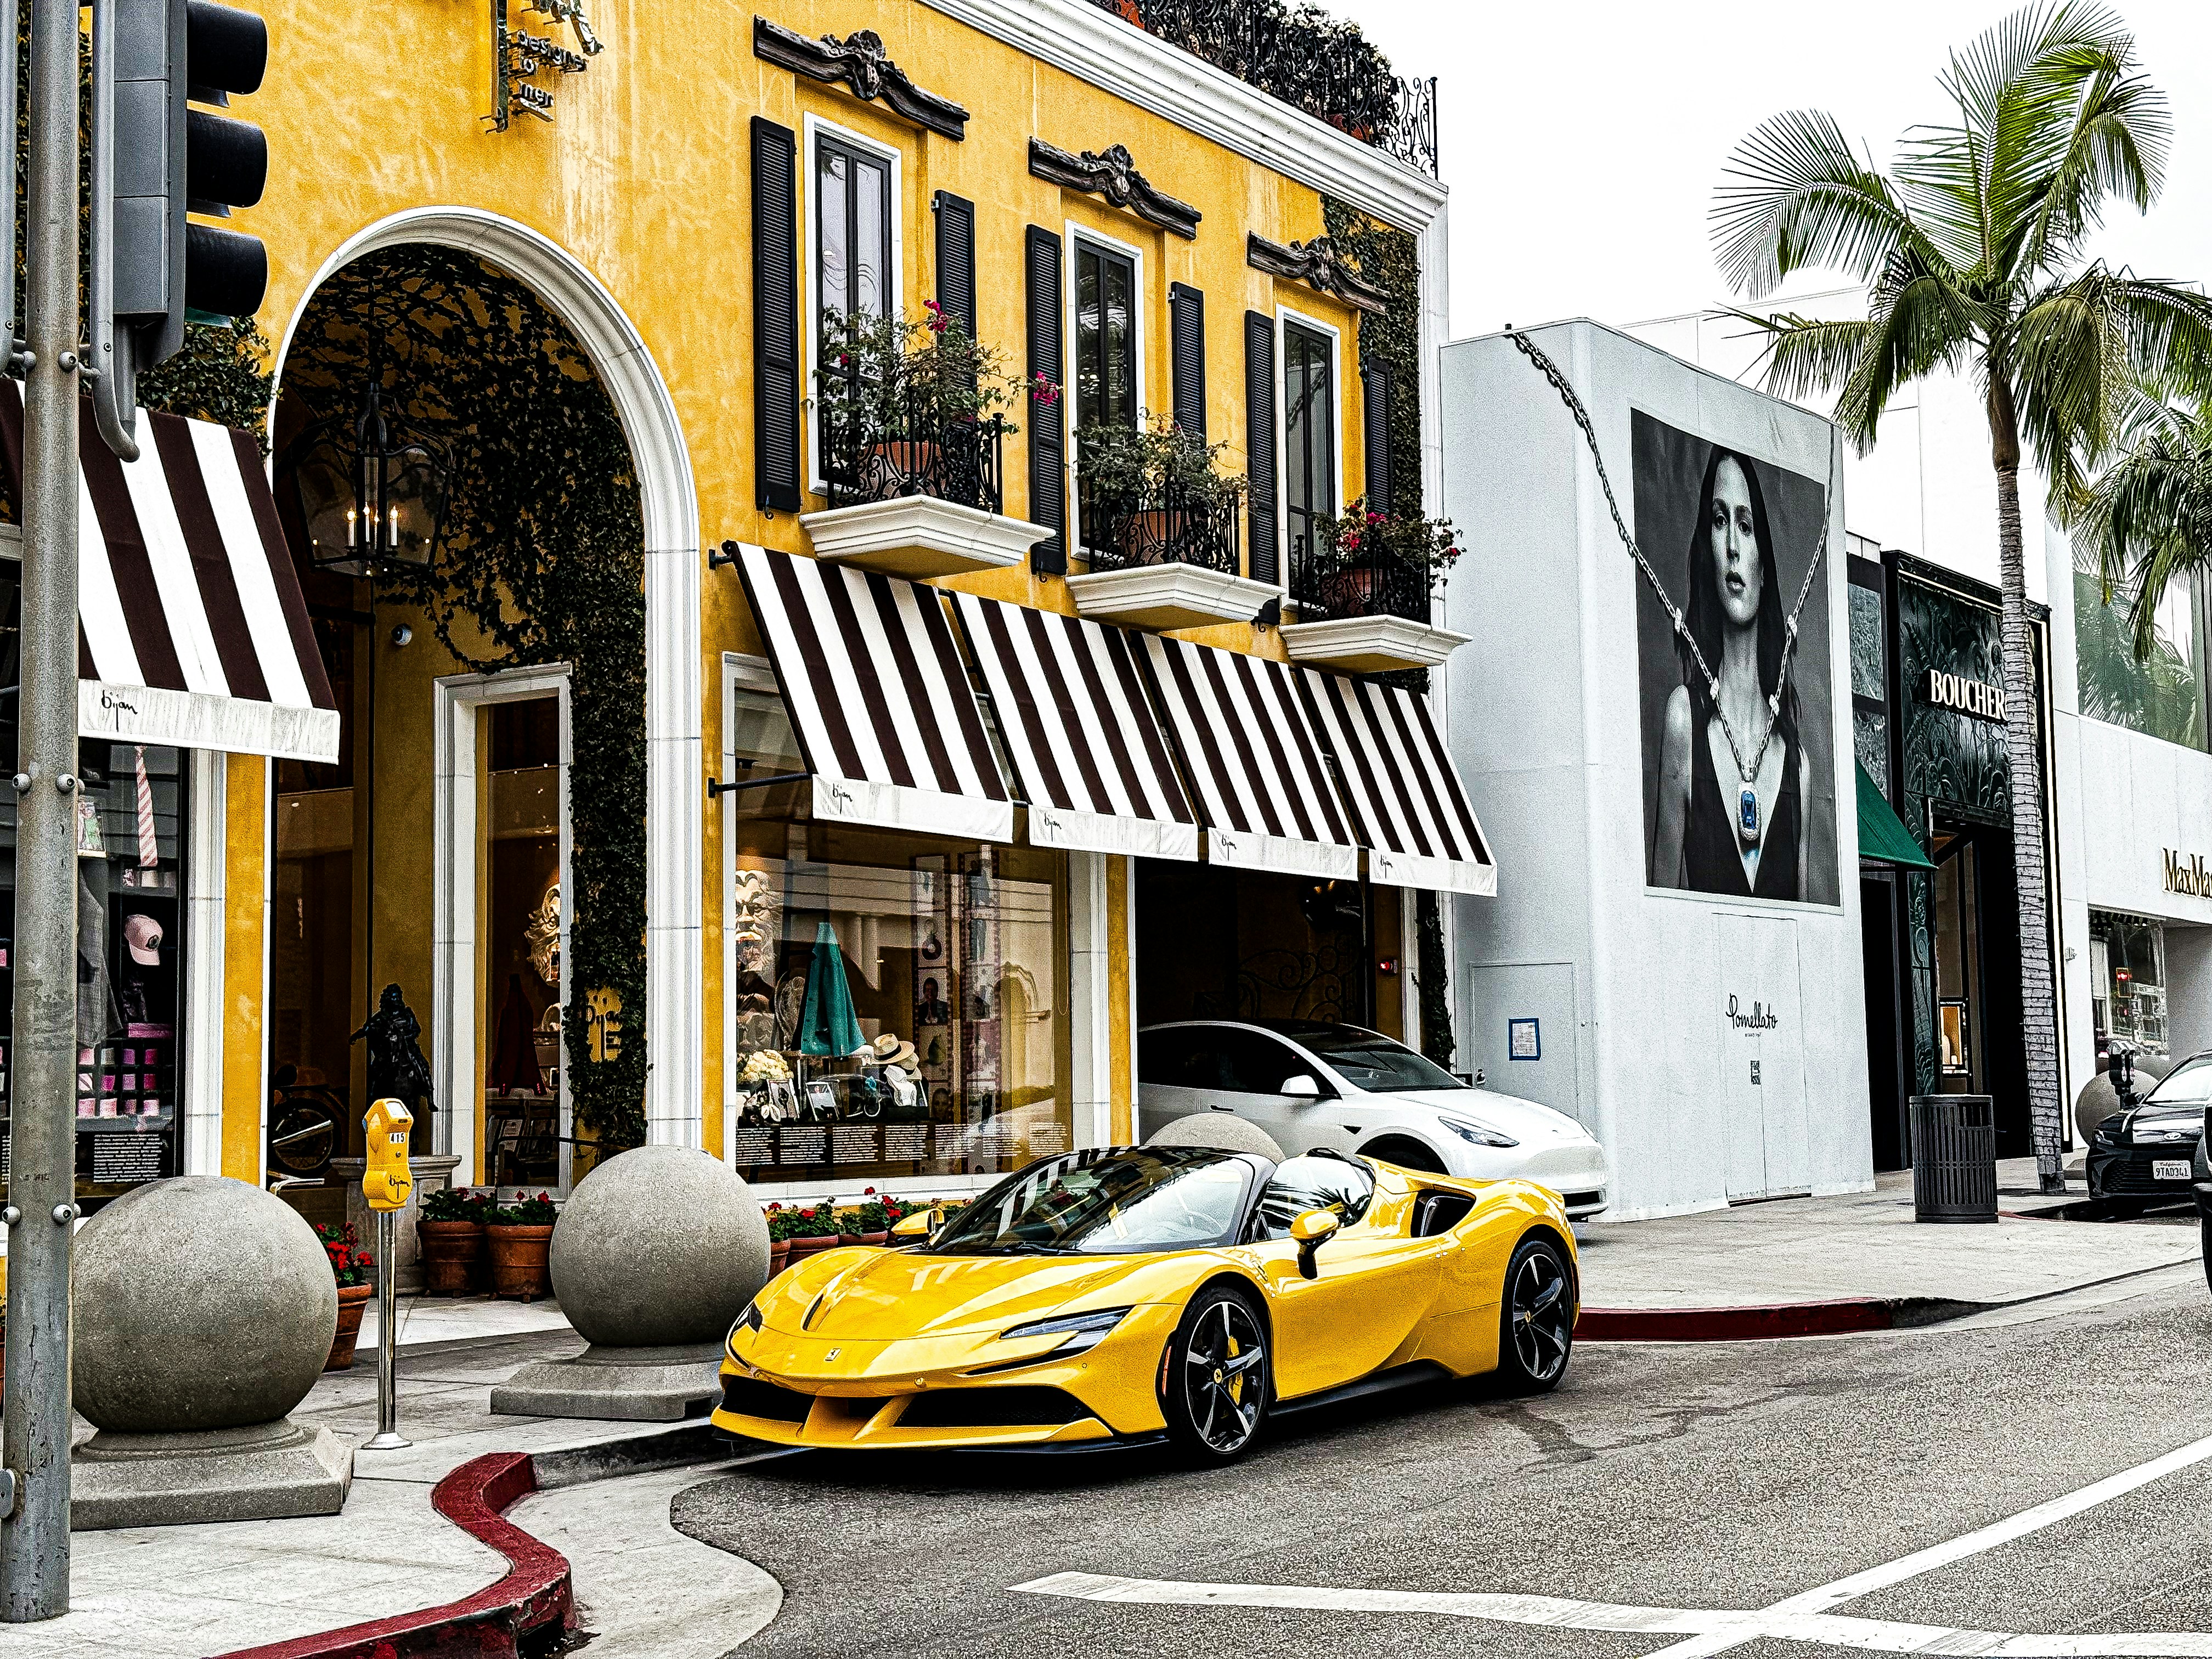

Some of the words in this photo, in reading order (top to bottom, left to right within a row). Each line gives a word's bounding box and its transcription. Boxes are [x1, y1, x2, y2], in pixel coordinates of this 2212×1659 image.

[517, 29, 586, 71] designs
[101, 689, 138, 732] bijan
[1931, 669, 2008, 721] BOUCHER
[2163, 847, 2212, 899] MaxMa
[1725, 992, 1778, 1030] Pomellato
[391, 1133, 405, 1143] 415
